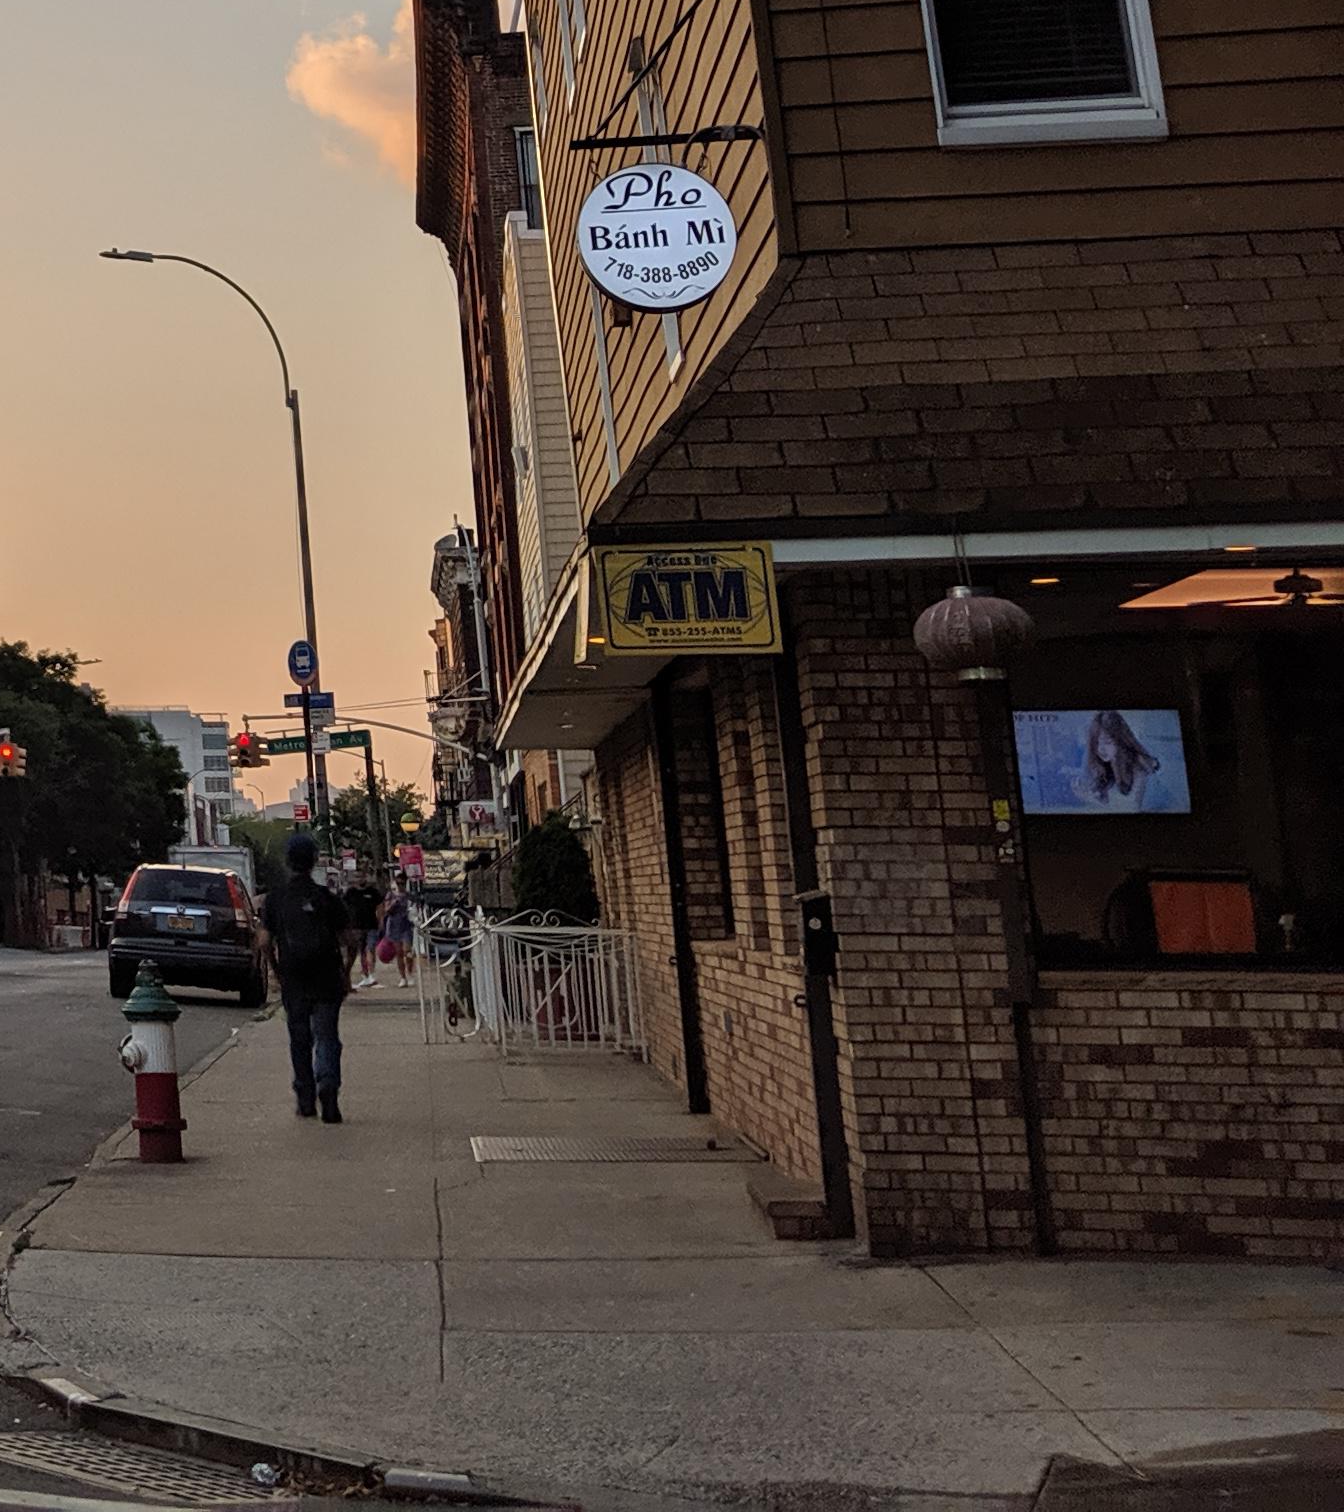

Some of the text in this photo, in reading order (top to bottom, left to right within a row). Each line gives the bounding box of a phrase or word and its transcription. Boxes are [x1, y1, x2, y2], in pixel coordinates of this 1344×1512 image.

[603, 170, 702, 209] Pho
[589, 218, 726, 251] Bánh Mì
[603, 250, 720, 283] 718-388-8890
[625, 568, 752, 623] ATM
